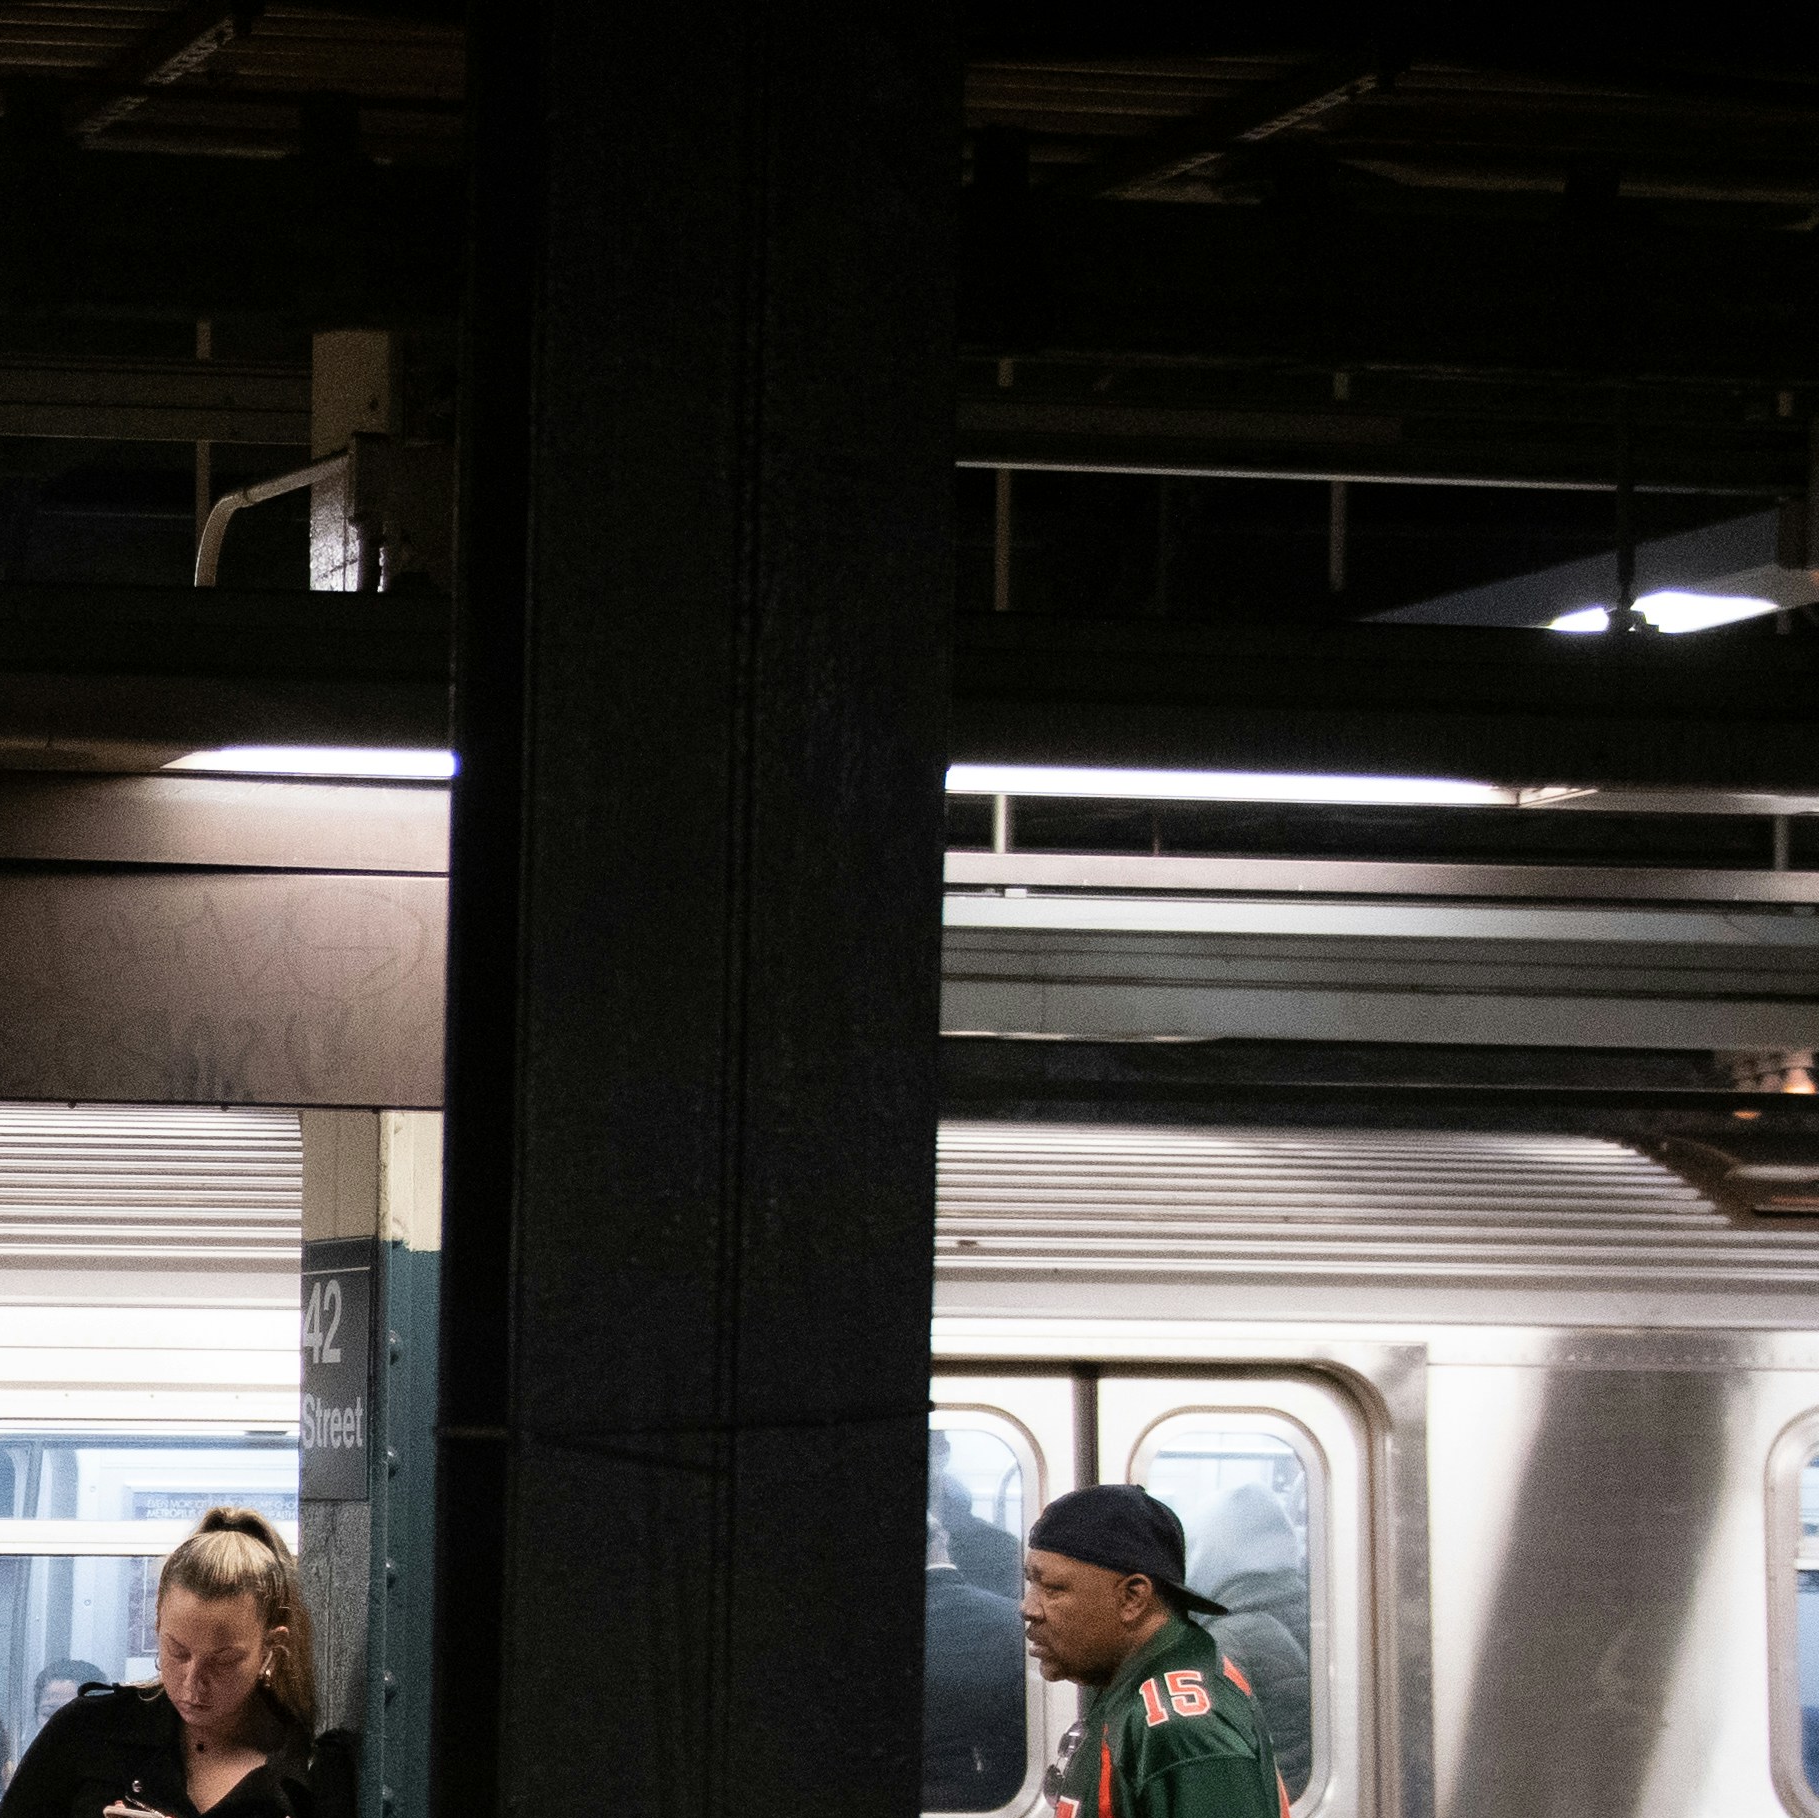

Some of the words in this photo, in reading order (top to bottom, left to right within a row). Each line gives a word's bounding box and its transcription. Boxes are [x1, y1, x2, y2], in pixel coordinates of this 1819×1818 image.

[303, 1279, 342, 1365] 42
[302, 1393, 364, 1450] Street
[1139, 1670, 1211, 1727] 15
